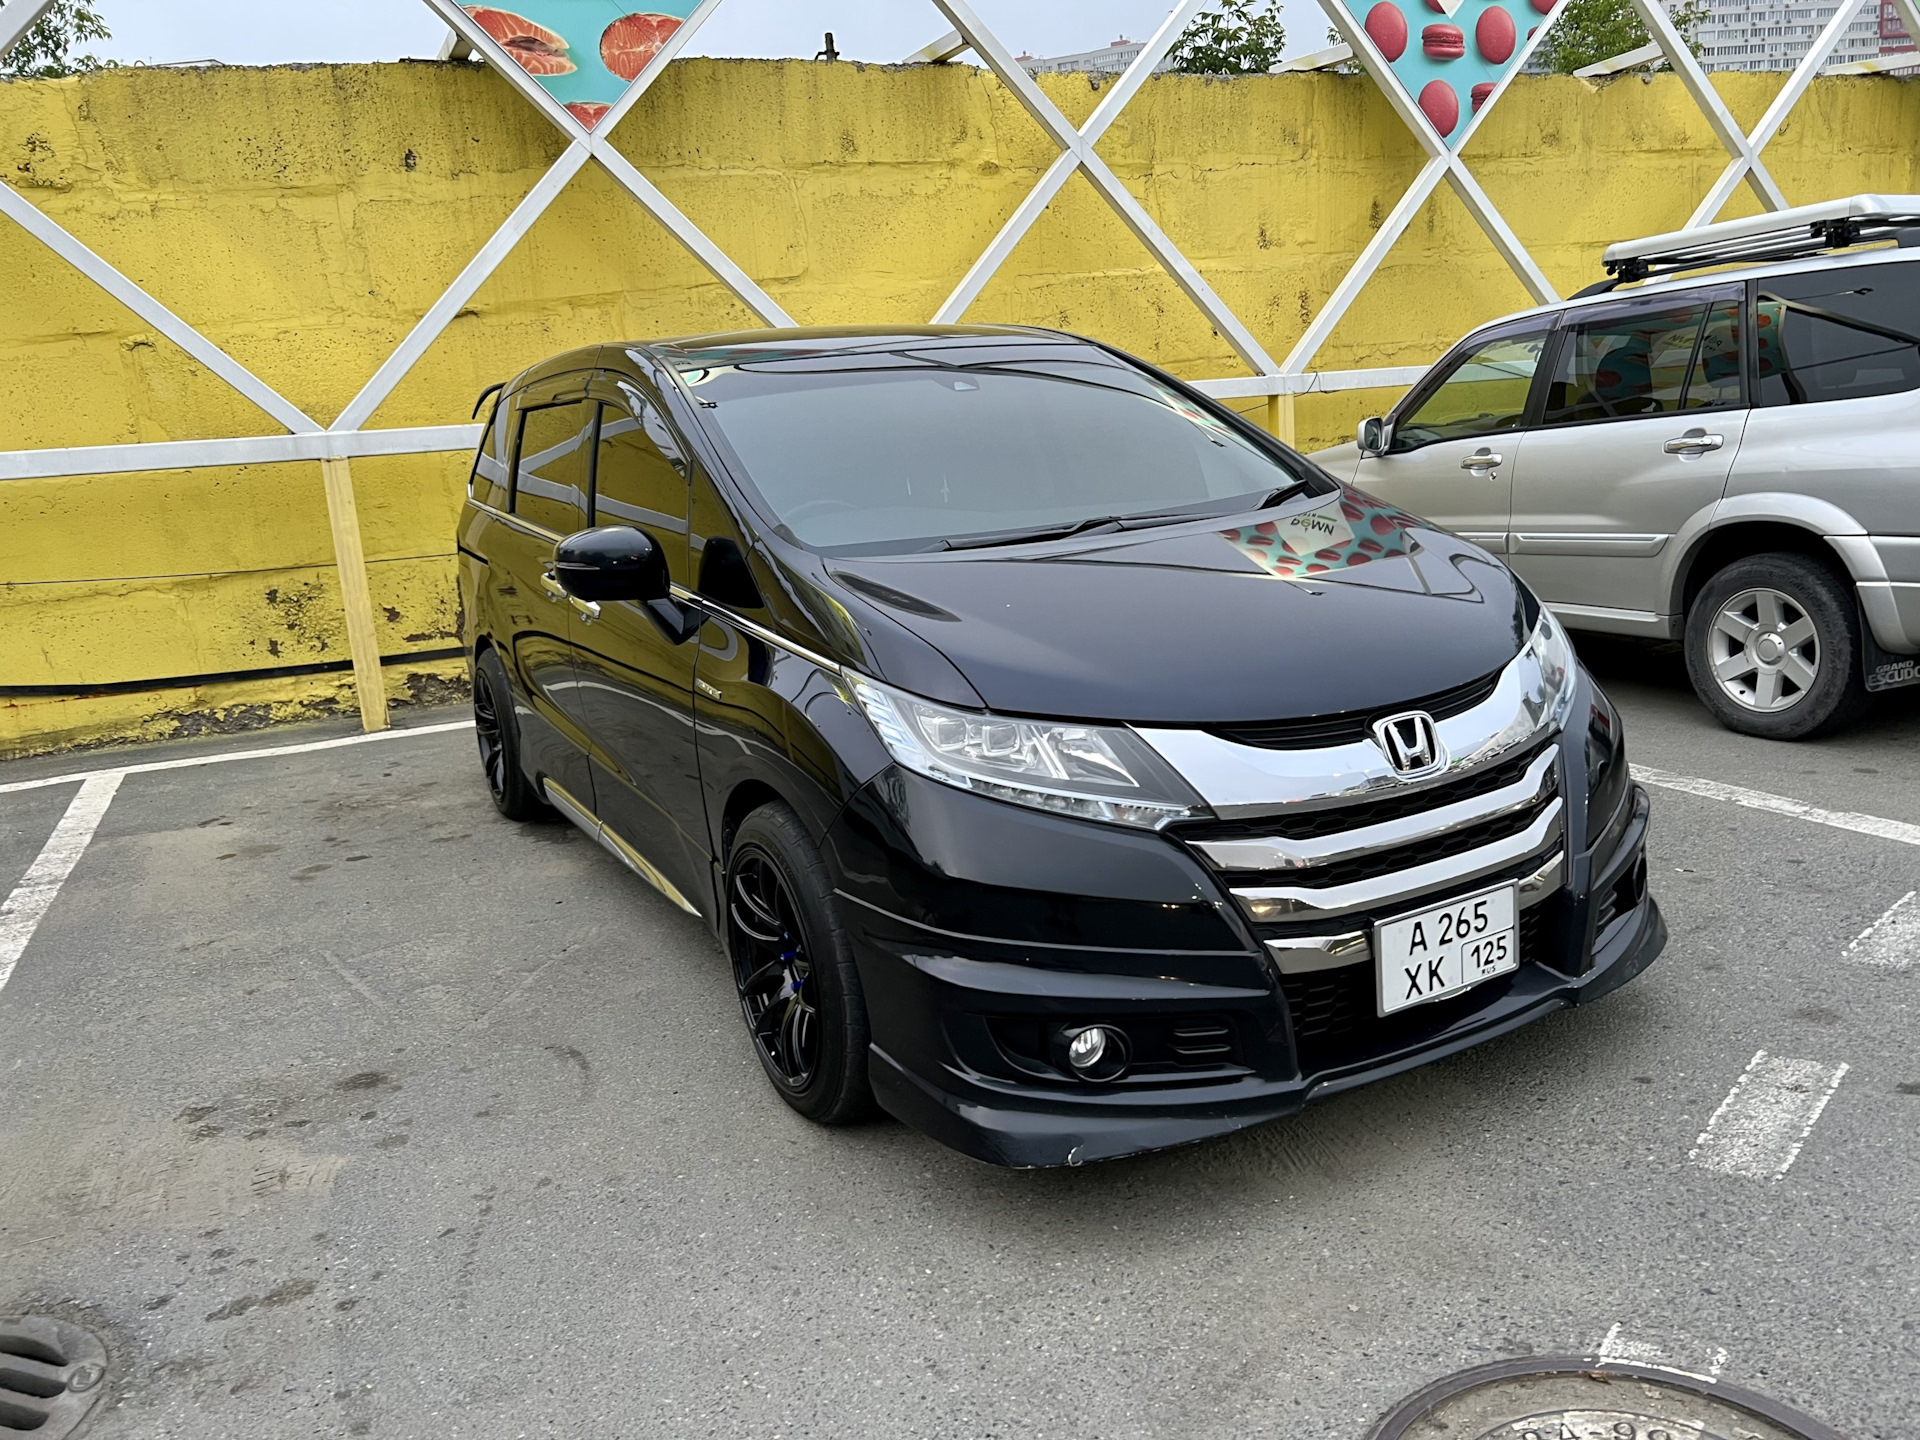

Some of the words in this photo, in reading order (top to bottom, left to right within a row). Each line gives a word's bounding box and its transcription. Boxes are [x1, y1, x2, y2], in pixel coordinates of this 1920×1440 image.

[1876, 660, 1914, 674] GRAND
[1438, 900, 1488, 946] 265
[1471, 935, 1507, 968] 125
[1481, 965, 1496, 975] RUS
